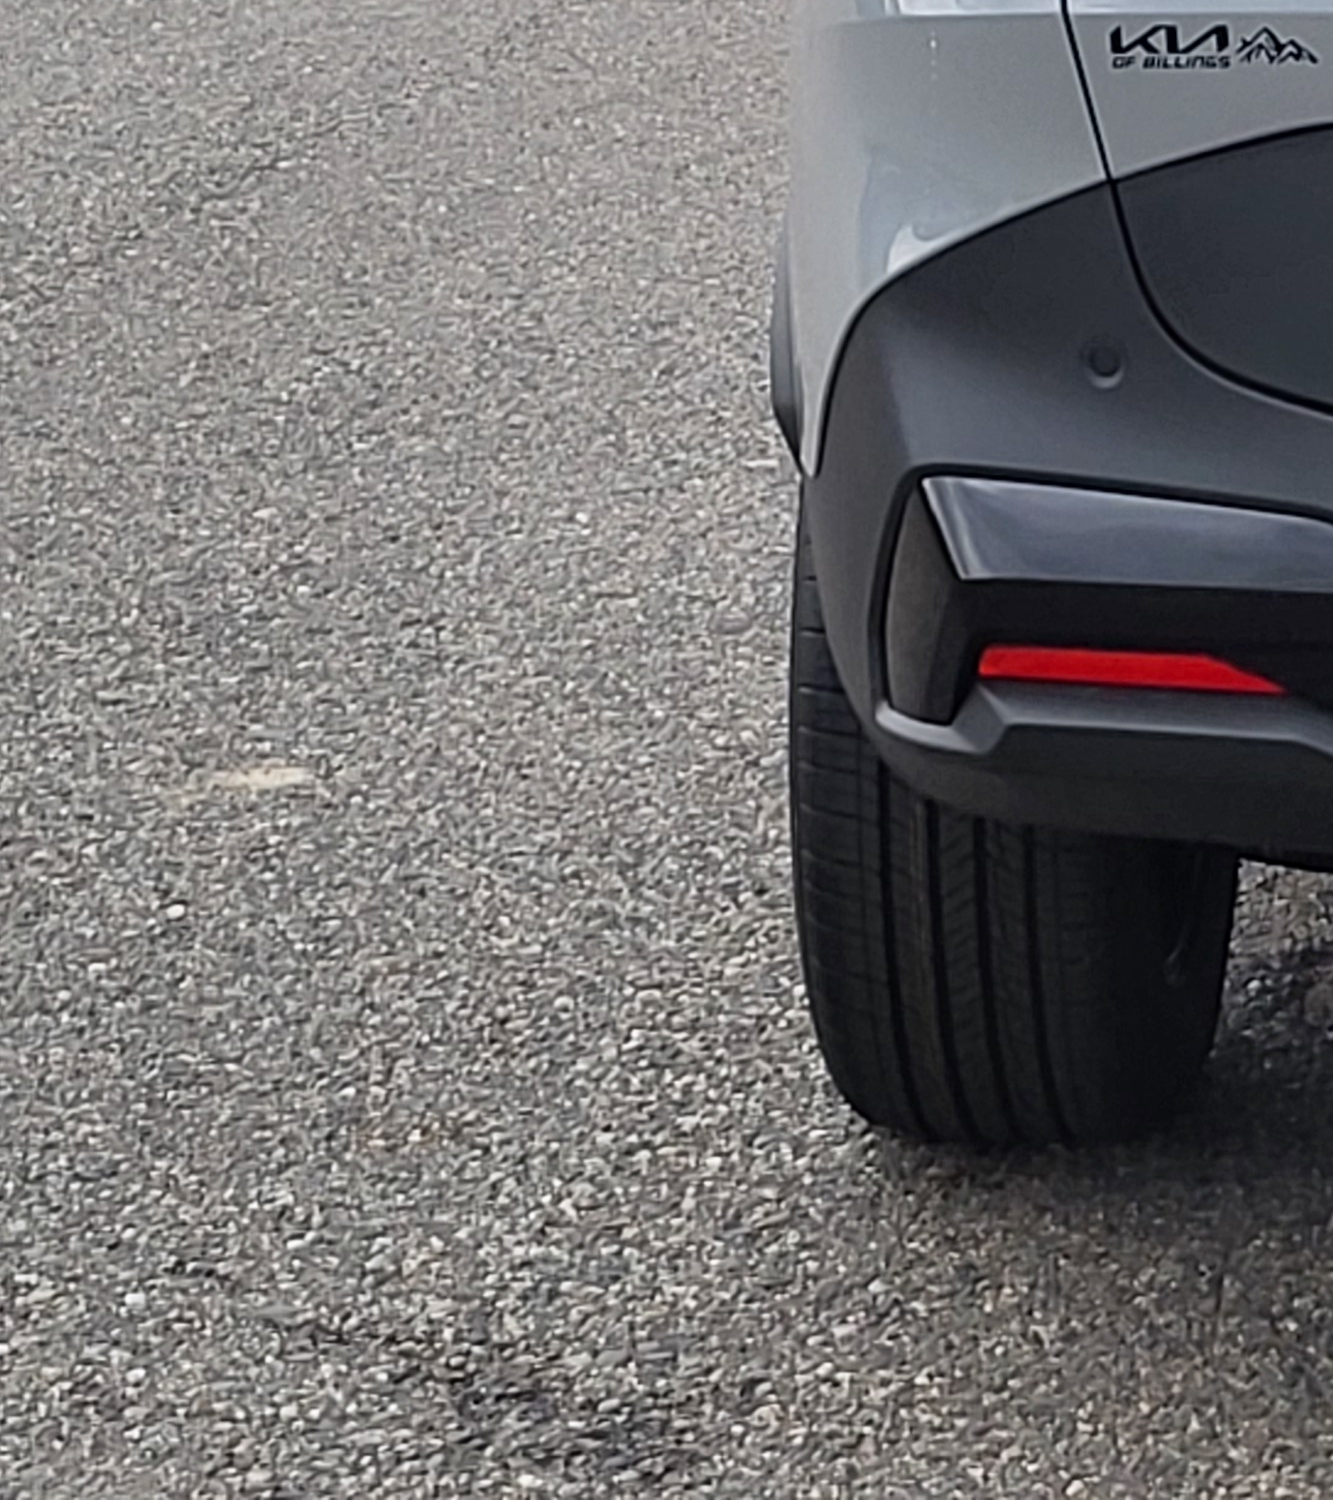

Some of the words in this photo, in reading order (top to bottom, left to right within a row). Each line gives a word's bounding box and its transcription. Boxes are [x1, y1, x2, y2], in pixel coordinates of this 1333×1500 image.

[1110, 24, 1229, 54] KIA
[1112, 56, 1135, 69] OF
[1142, 56, 1230, 69] BILLINGS
